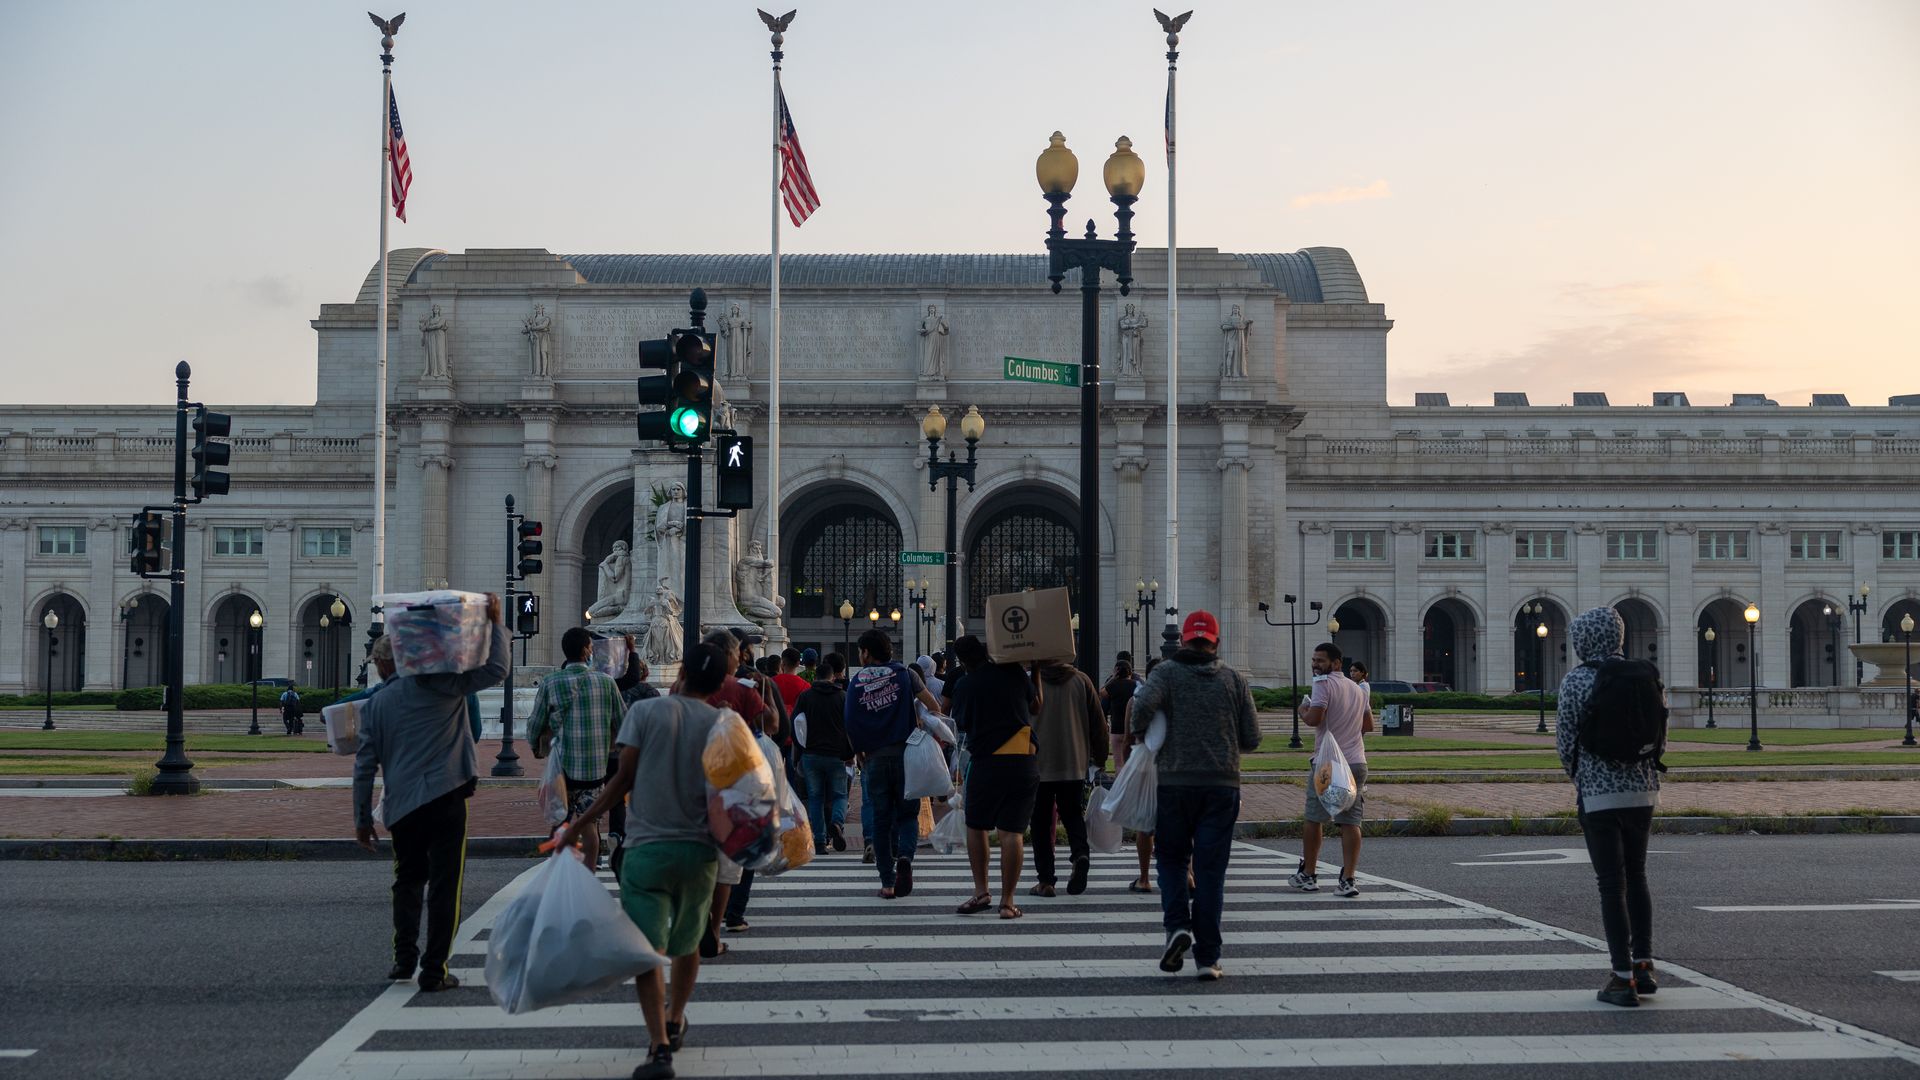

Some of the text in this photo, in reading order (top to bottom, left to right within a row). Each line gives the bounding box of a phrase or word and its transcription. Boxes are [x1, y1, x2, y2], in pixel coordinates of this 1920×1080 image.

[1008, 360, 1059, 382] Columbus
[902, 553, 933, 563] Columbus
[866, 693, 898, 711] ALWAYS
